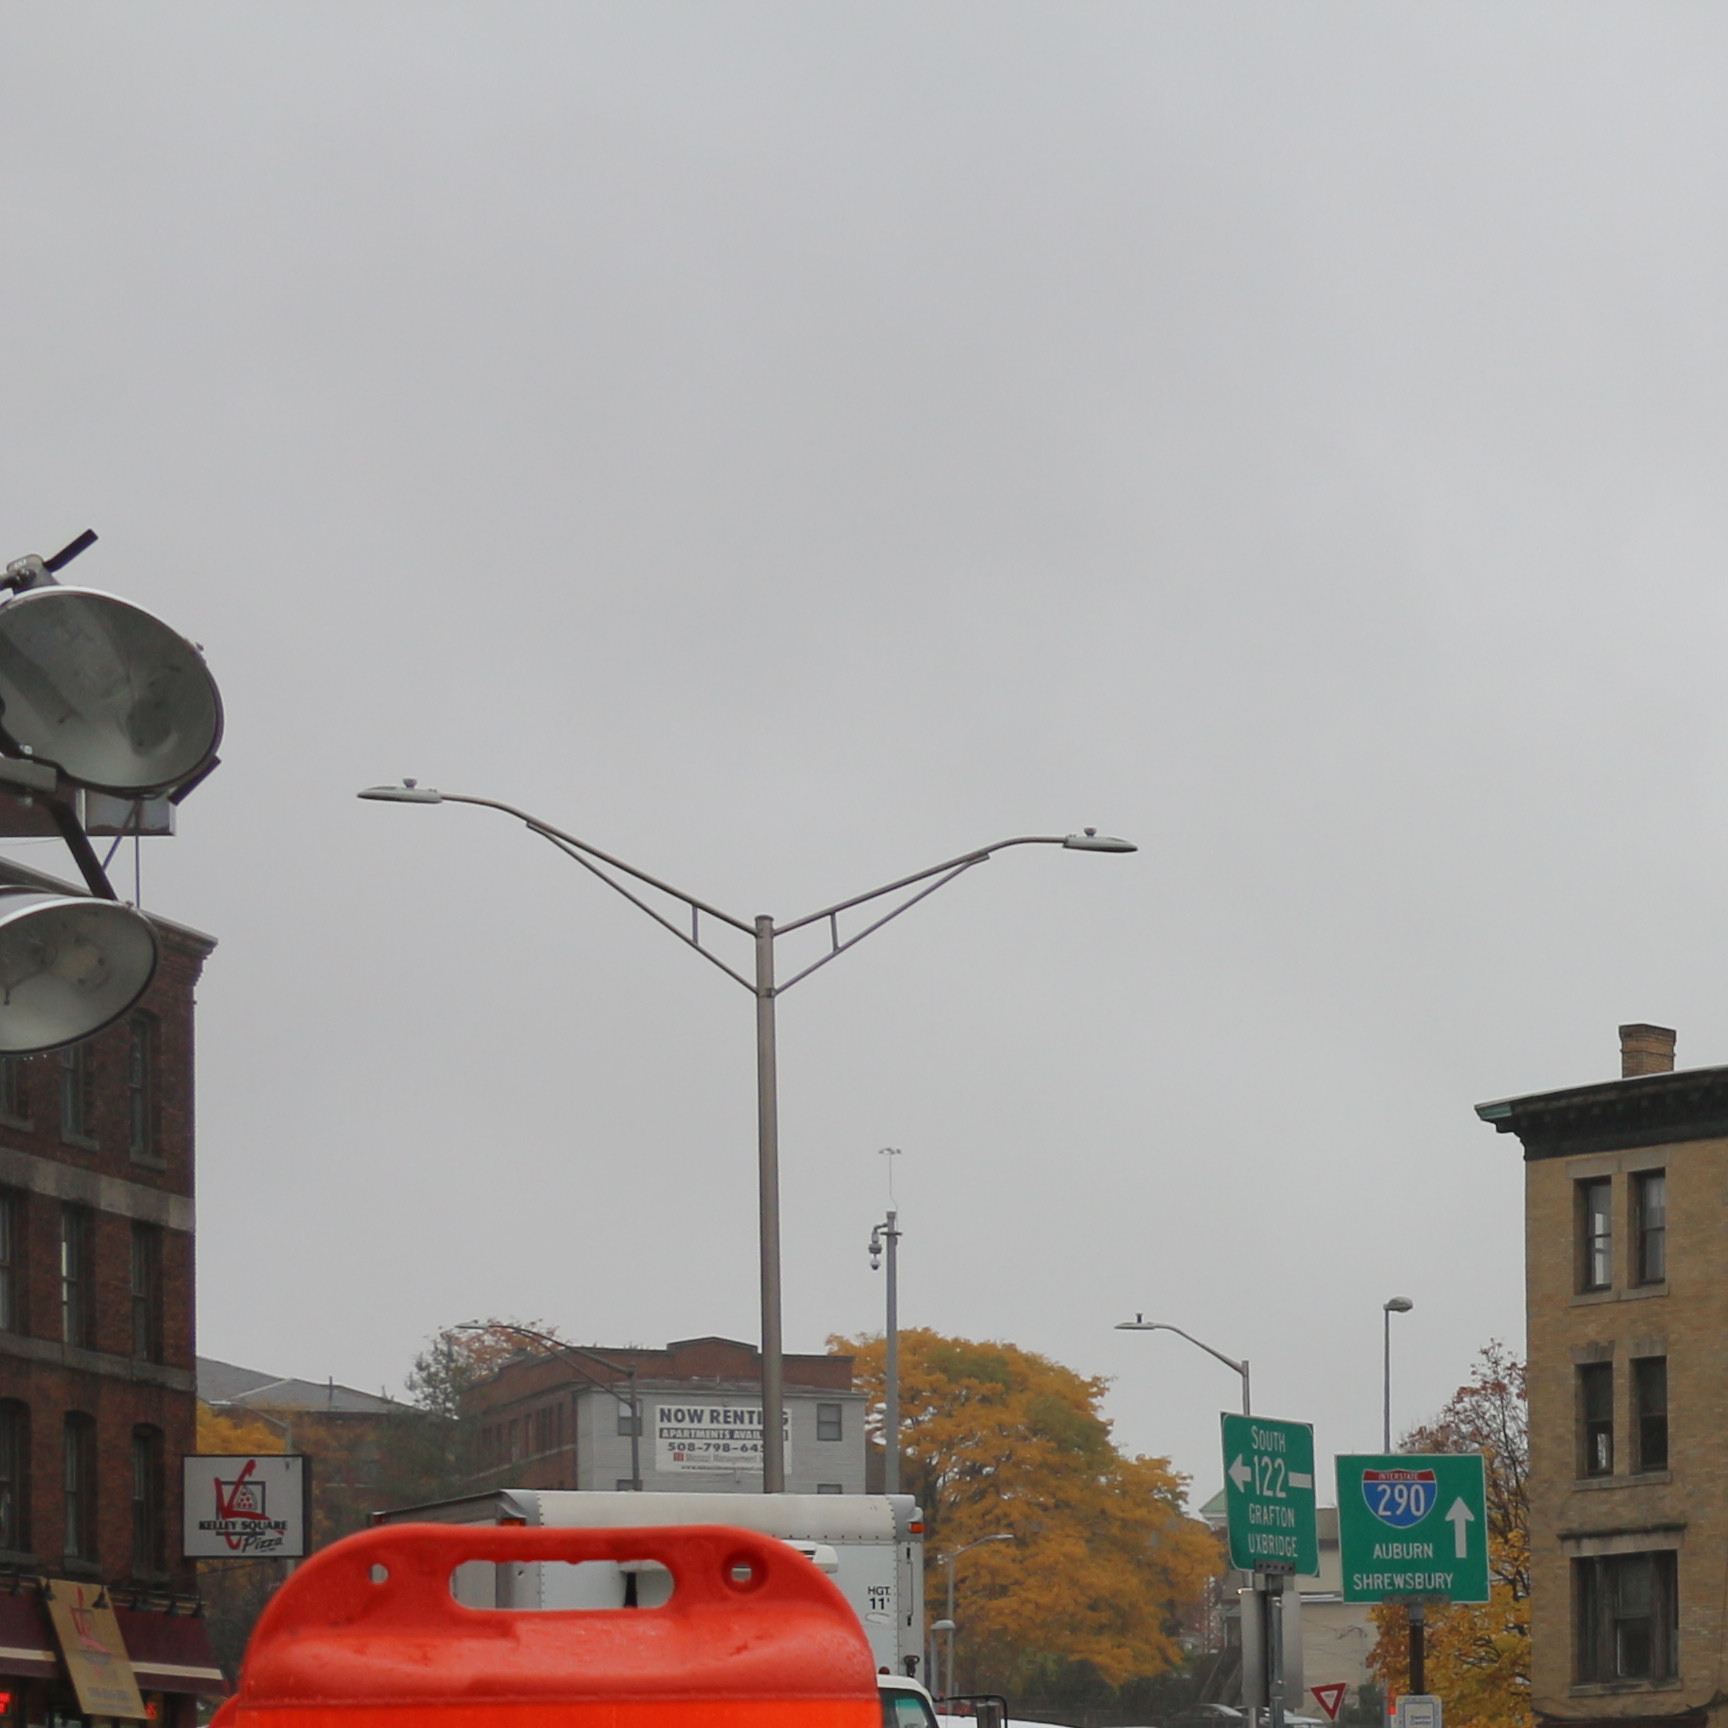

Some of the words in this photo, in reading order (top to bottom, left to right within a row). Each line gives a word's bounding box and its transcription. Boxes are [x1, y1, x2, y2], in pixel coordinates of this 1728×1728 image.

[659, 1407, 704, 1424] NOW
[661, 1429, 731, 1439] APARTMENTS
[1251, 1425, 1286, 1453] SOUTH
[1253, 1455, 1287, 1498] 122
[1378, 1472, 1419, 1481] INTERSTATE
[1377, 1484, 1425, 1517] 290
[1249, 1503, 1295, 1528] GRAFTON
[198, 1521, 237, 1530] KELLEY
[241, 1521, 288, 1531] SQUARE
[241, 1536, 284, 1553] Pizza
[1248, 1533, 1298, 1557] UXBRIDGE
[1373, 1543, 1433, 1559] AUBURN
[1353, 1573, 1454, 1590] SHREWSBURY
